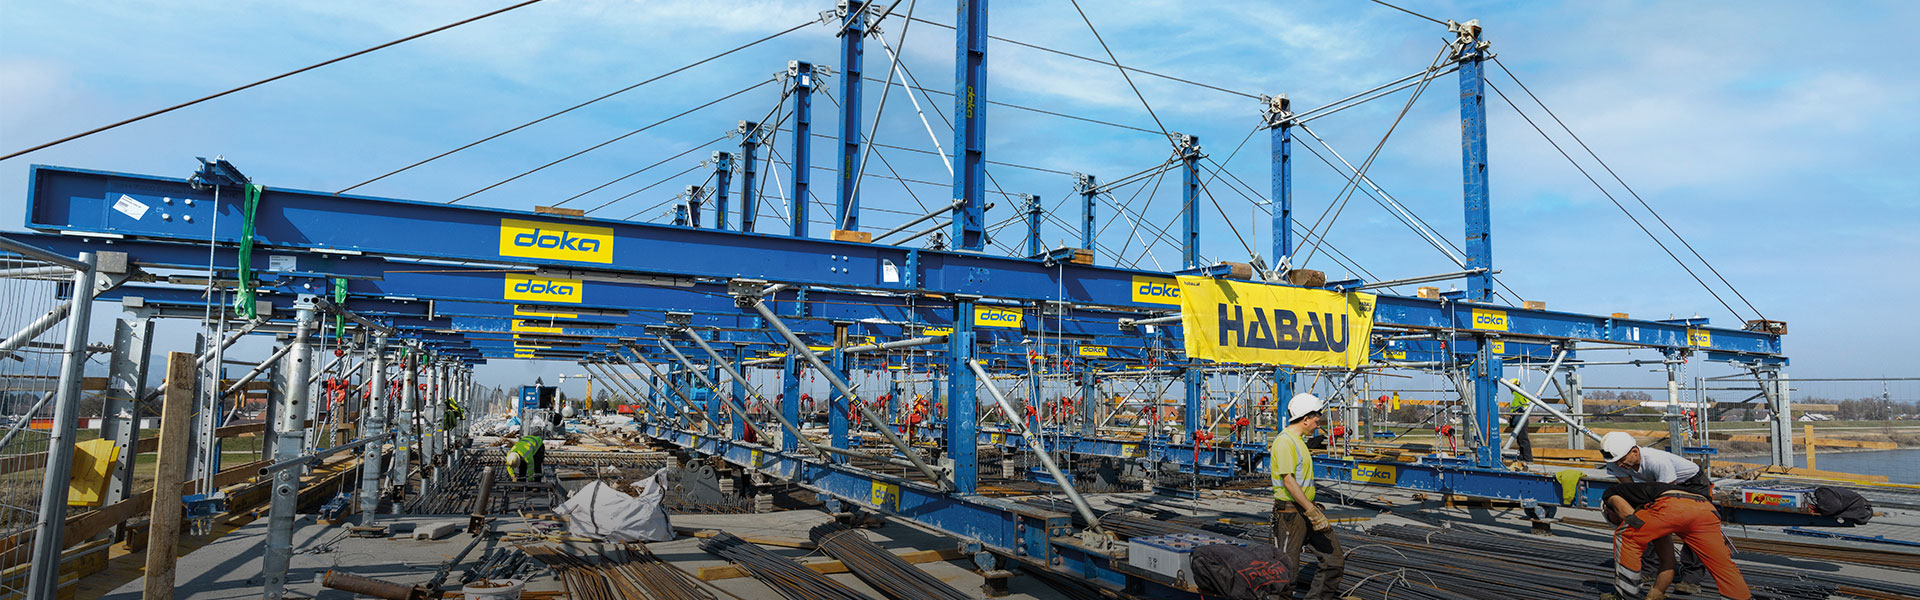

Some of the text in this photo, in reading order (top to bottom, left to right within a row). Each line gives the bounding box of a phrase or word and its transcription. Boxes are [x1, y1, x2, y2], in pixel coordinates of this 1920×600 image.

[966, 85, 975, 119] doka
[514, 228, 600, 252] doka
[514, 279, 574, 295] doka
[980, 309, 1017, 322] doka
[1476, 314, 1503, 325] doka
[1218, 303, 1350, 353] HABAU
[1357, 467, 1391, 479] doka
